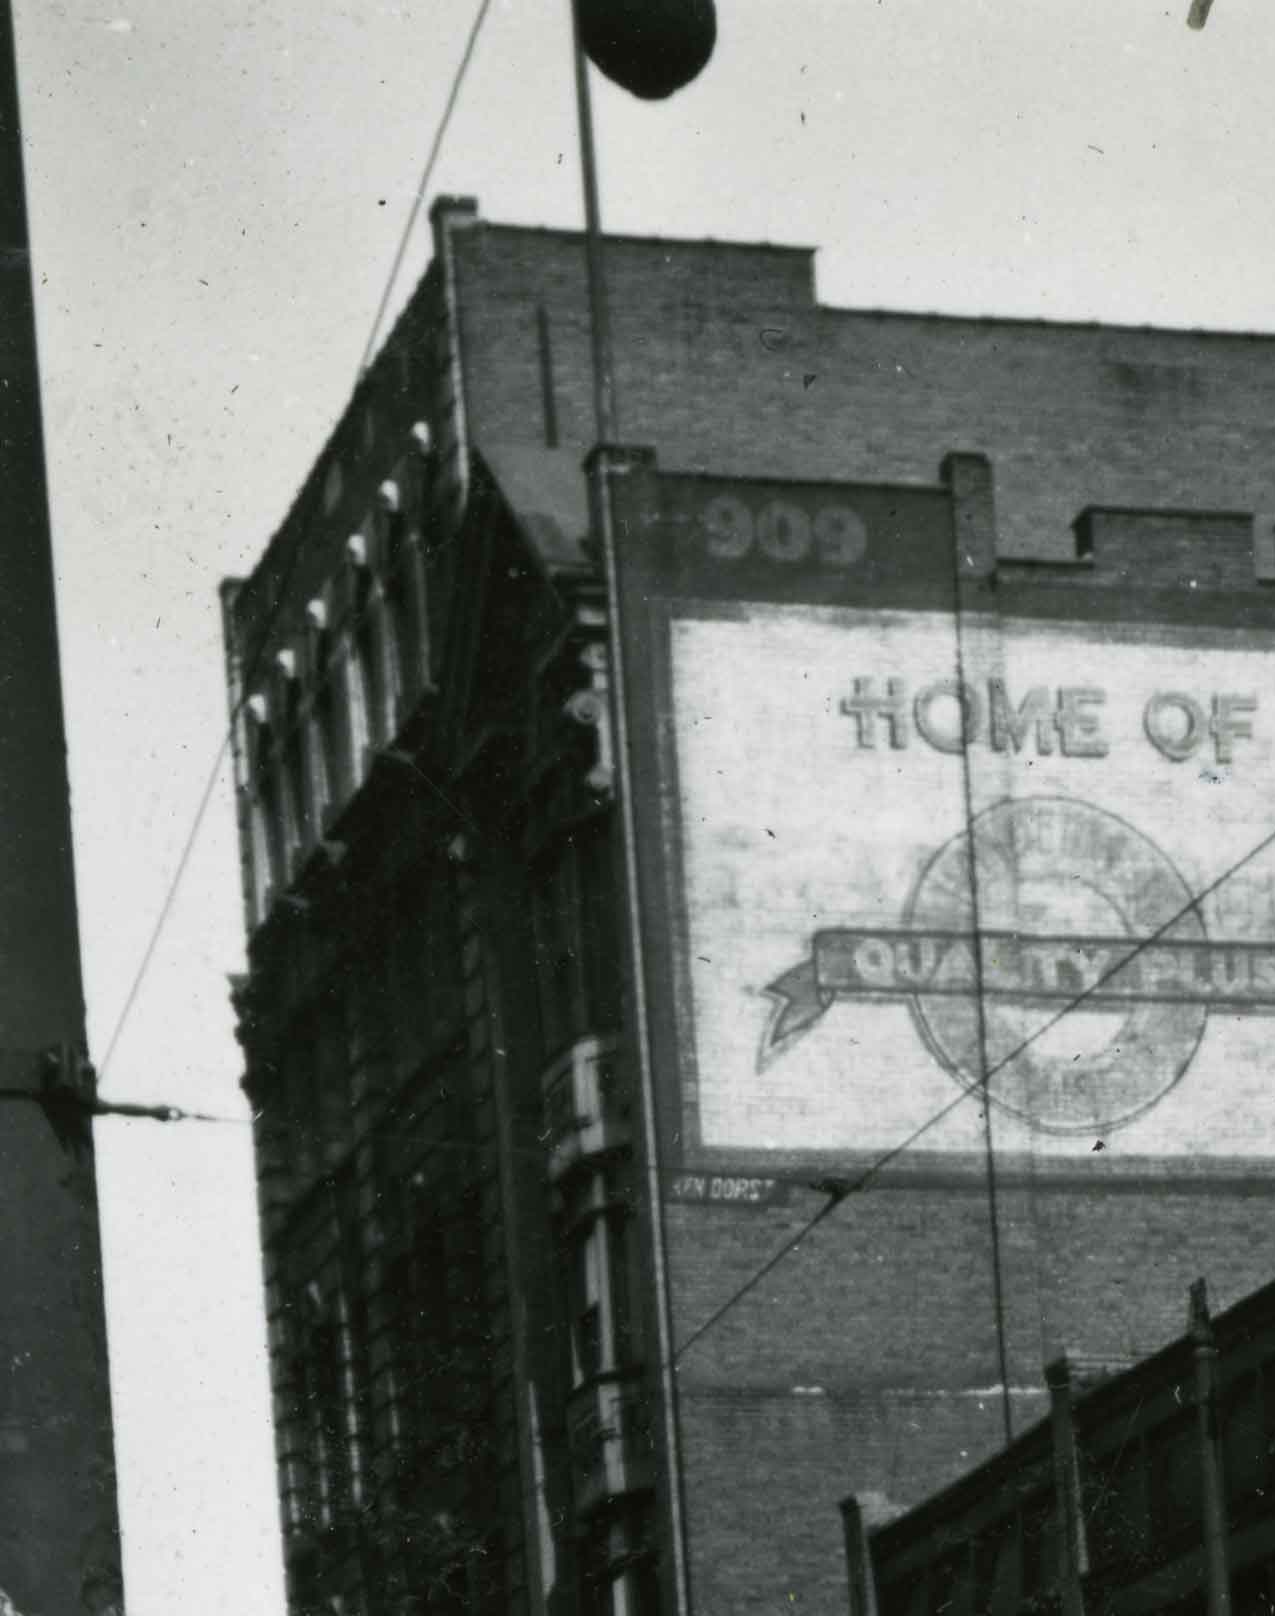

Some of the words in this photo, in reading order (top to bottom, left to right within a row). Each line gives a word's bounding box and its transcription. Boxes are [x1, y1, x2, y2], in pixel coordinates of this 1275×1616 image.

[702, 495, 868, 566] 909
[839, 675, 1108, 759] HOME
[1143, 690, 1258, 764] OF
[853, 936, 1110, 990] QUALITY
